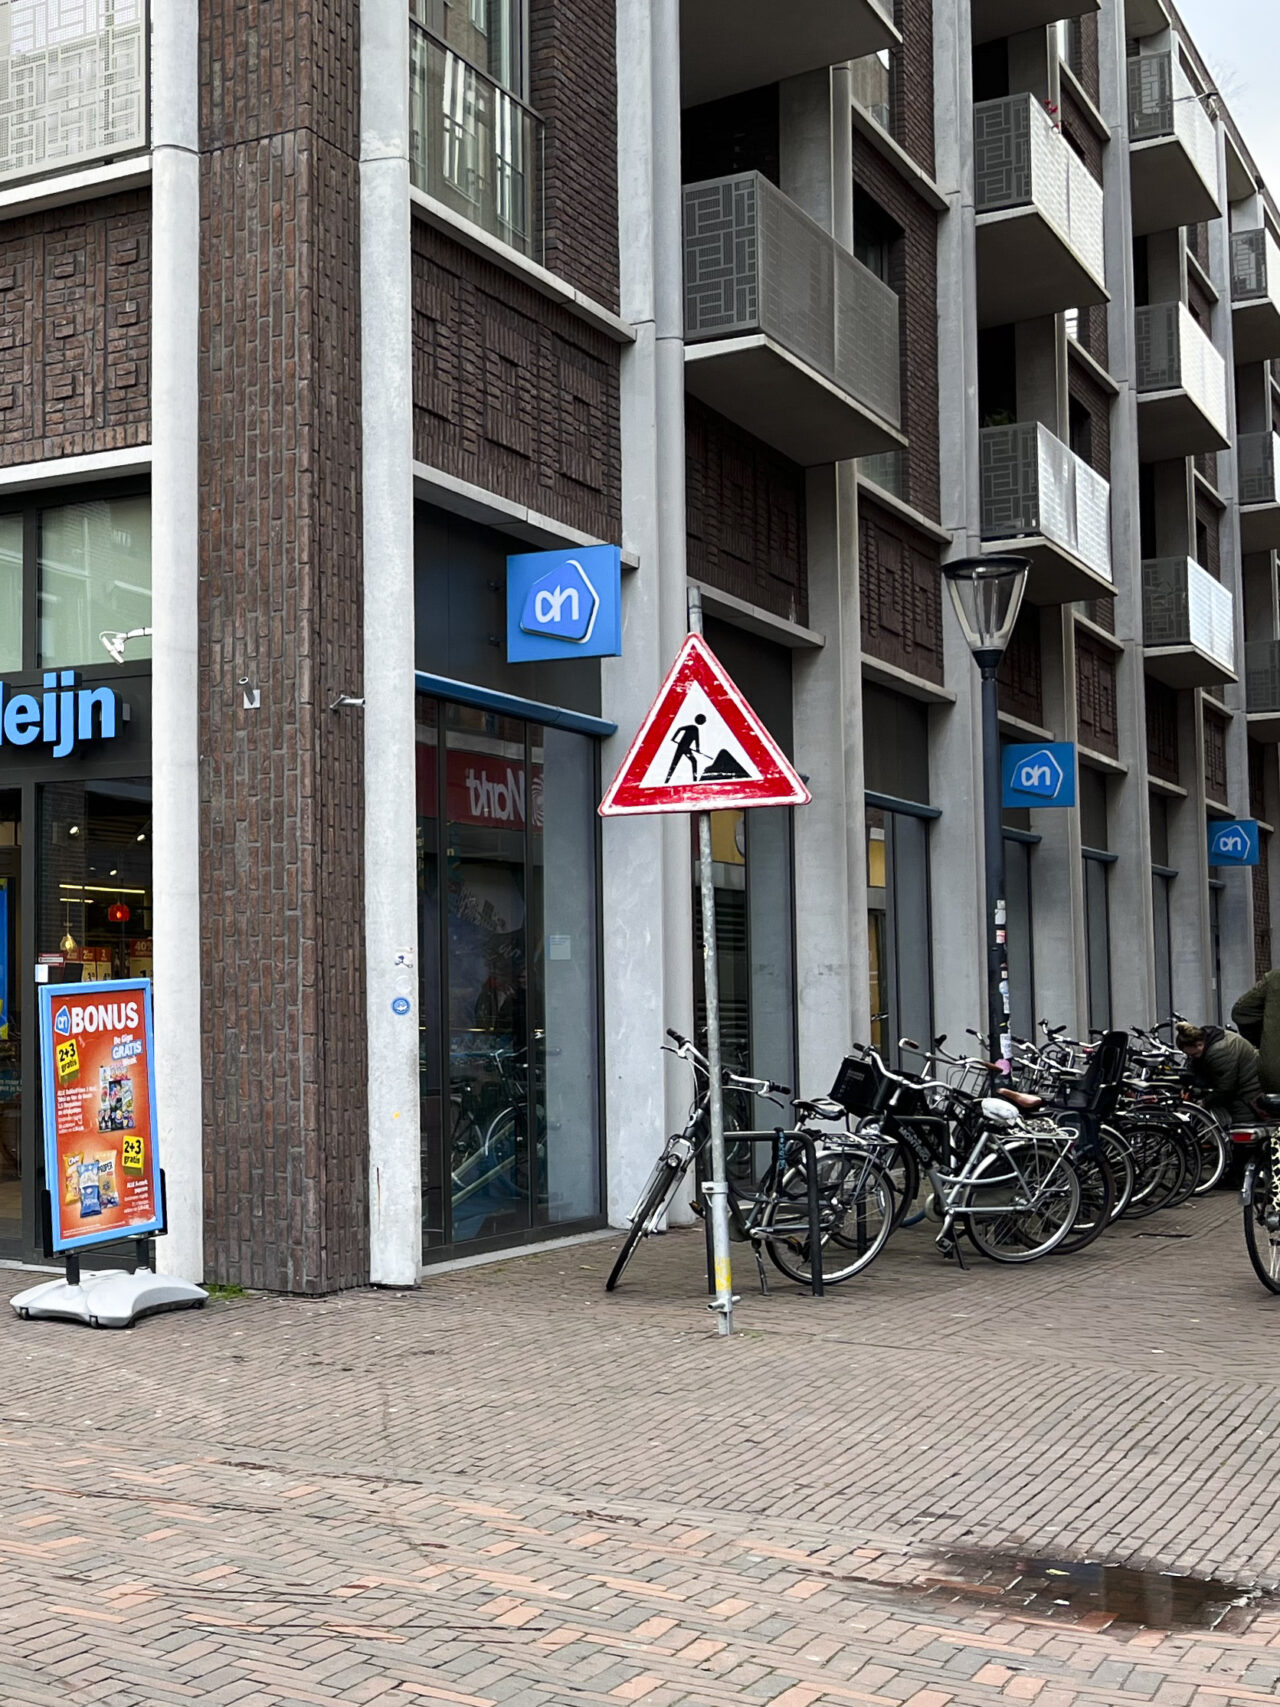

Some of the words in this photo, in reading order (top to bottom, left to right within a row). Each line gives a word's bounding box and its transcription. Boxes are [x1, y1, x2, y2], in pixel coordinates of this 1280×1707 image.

[71, 1002, 139, 1034] BONUS
[59, 1042, 76, 1062] 2+3
[112, 1041, 142, 1060] GRATIS
[124, 1139, 141, 1155] 2+3
[898, 1126, 929, 1162] MONTEGO
